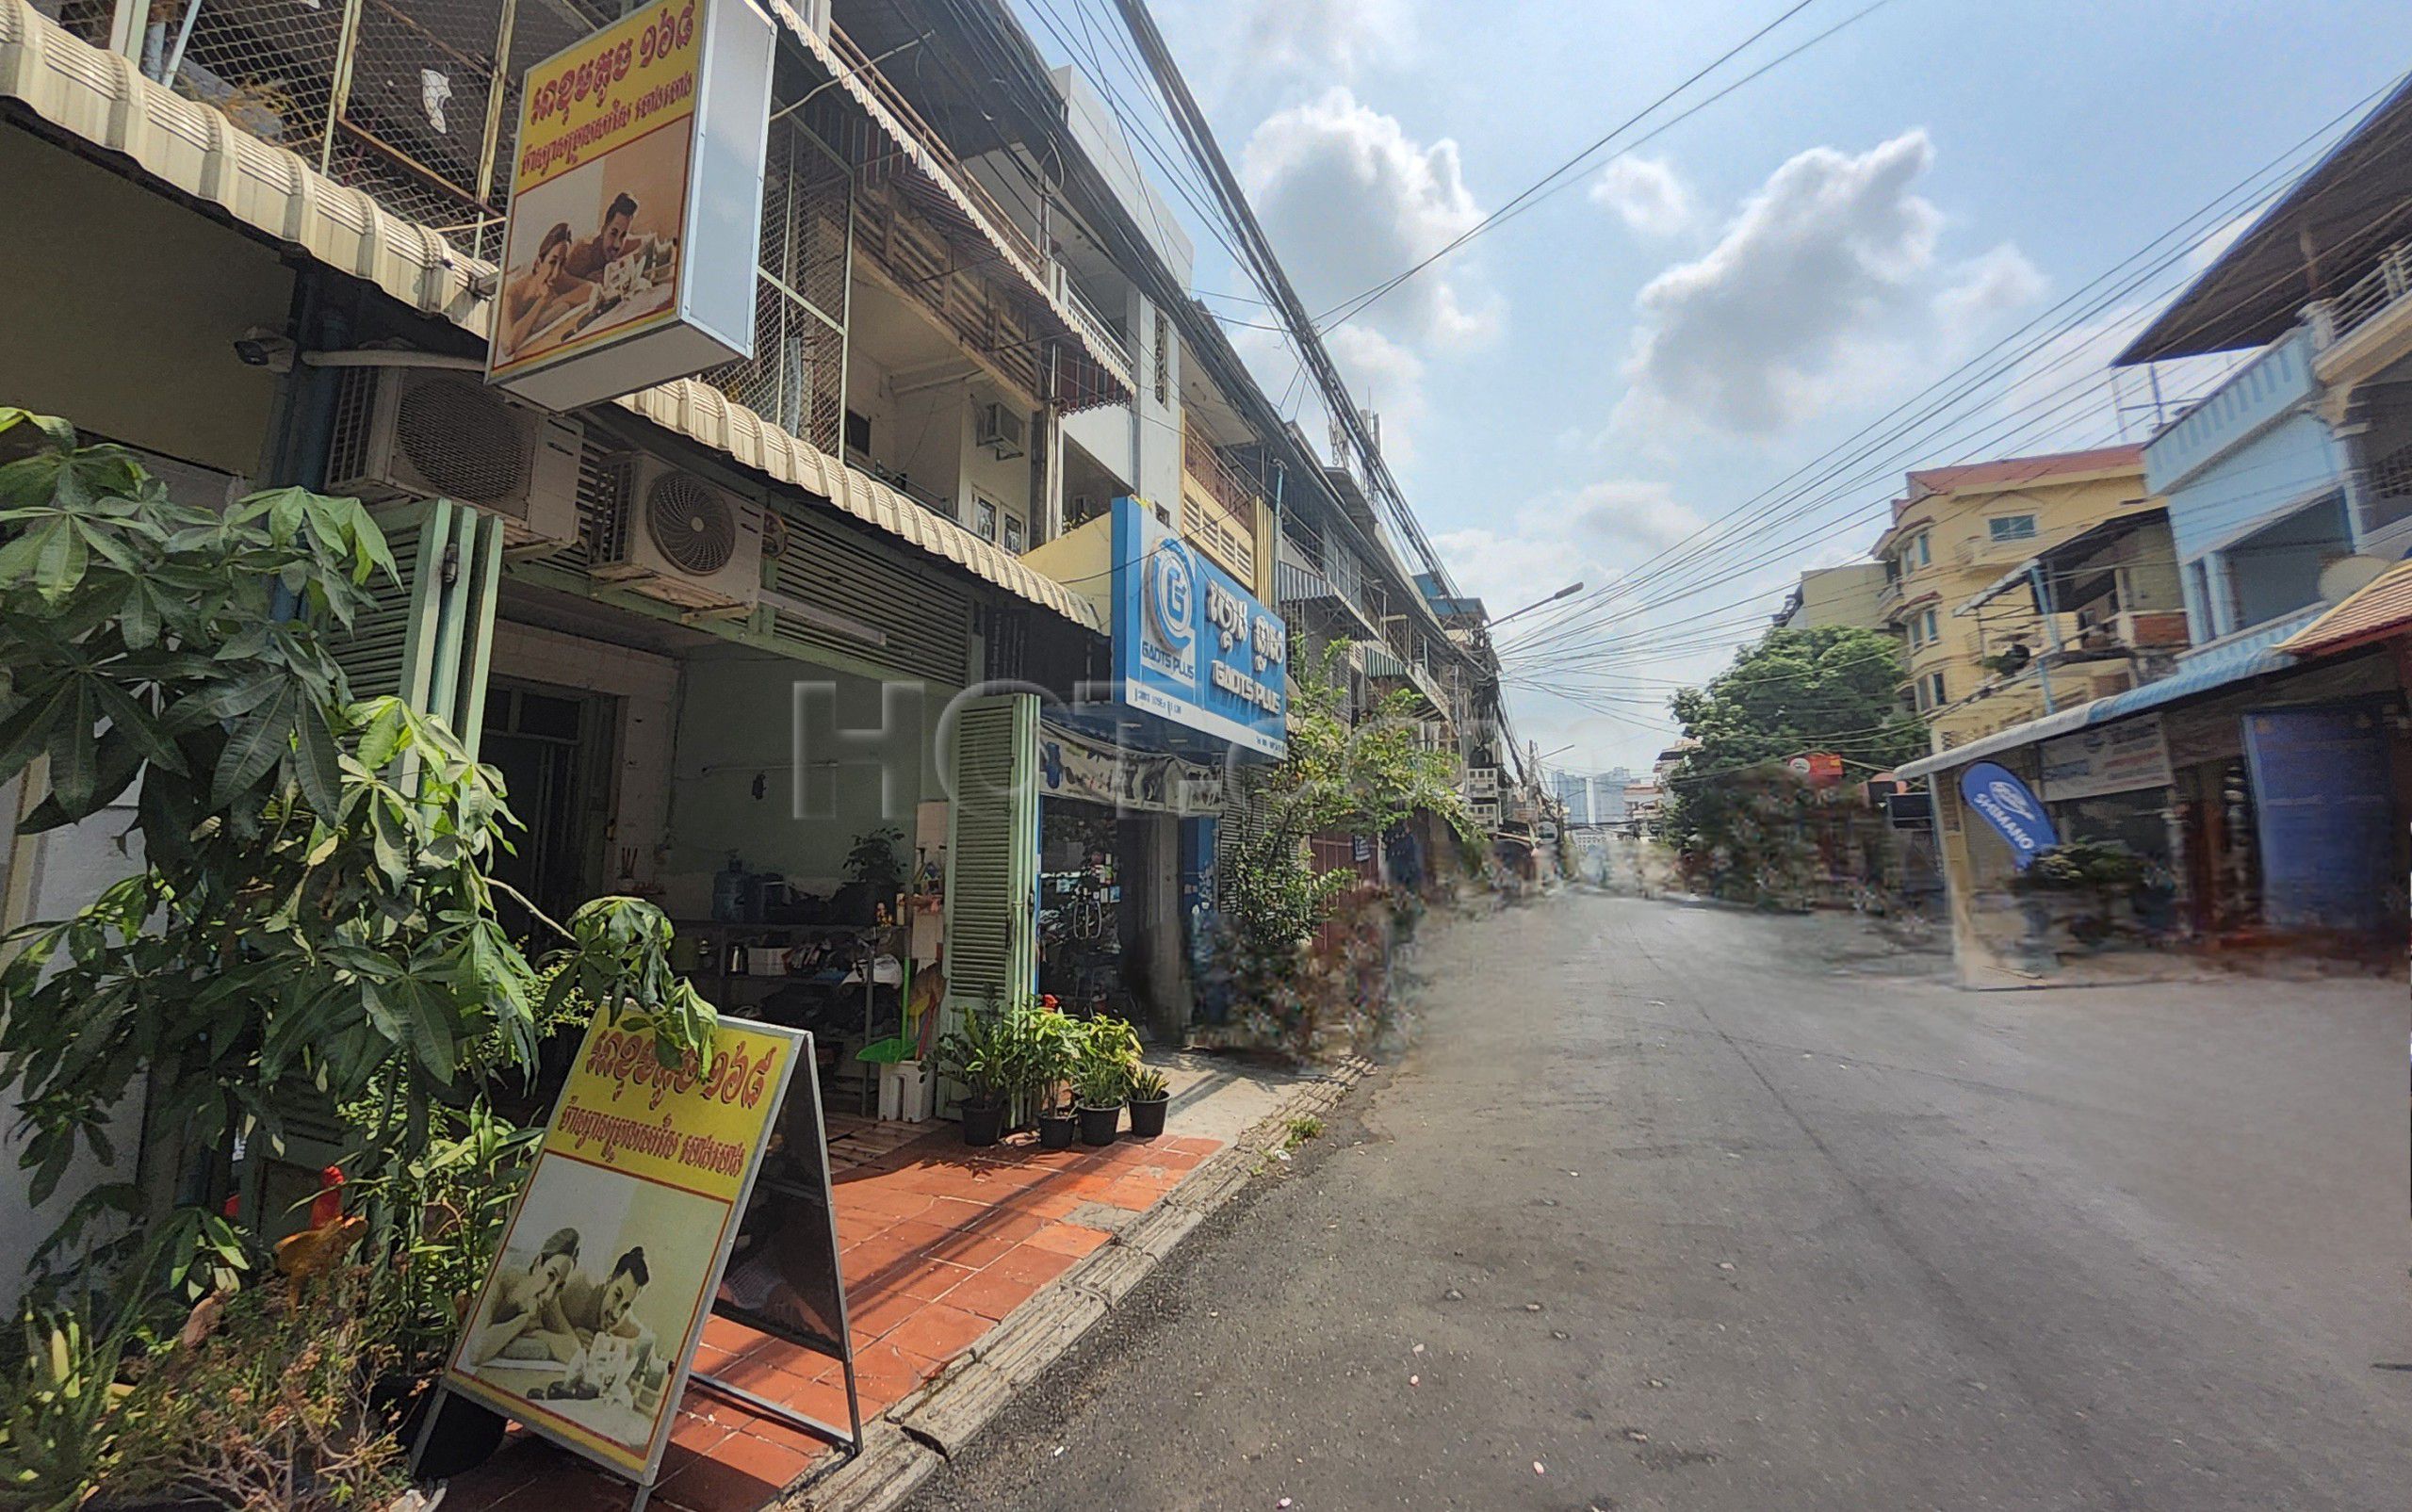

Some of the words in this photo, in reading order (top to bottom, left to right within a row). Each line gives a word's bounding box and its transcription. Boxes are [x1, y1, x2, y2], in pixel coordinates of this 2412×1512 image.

[639, 0, 697, 68] ១៦៨
[1172, 657, 1195, 679] PLUS
[1254, 682, 1281, 715] PLUS
[1974, 793, 2034, 849] SHIMANO
[699, 1040, 777, 1110] ១៦៨
